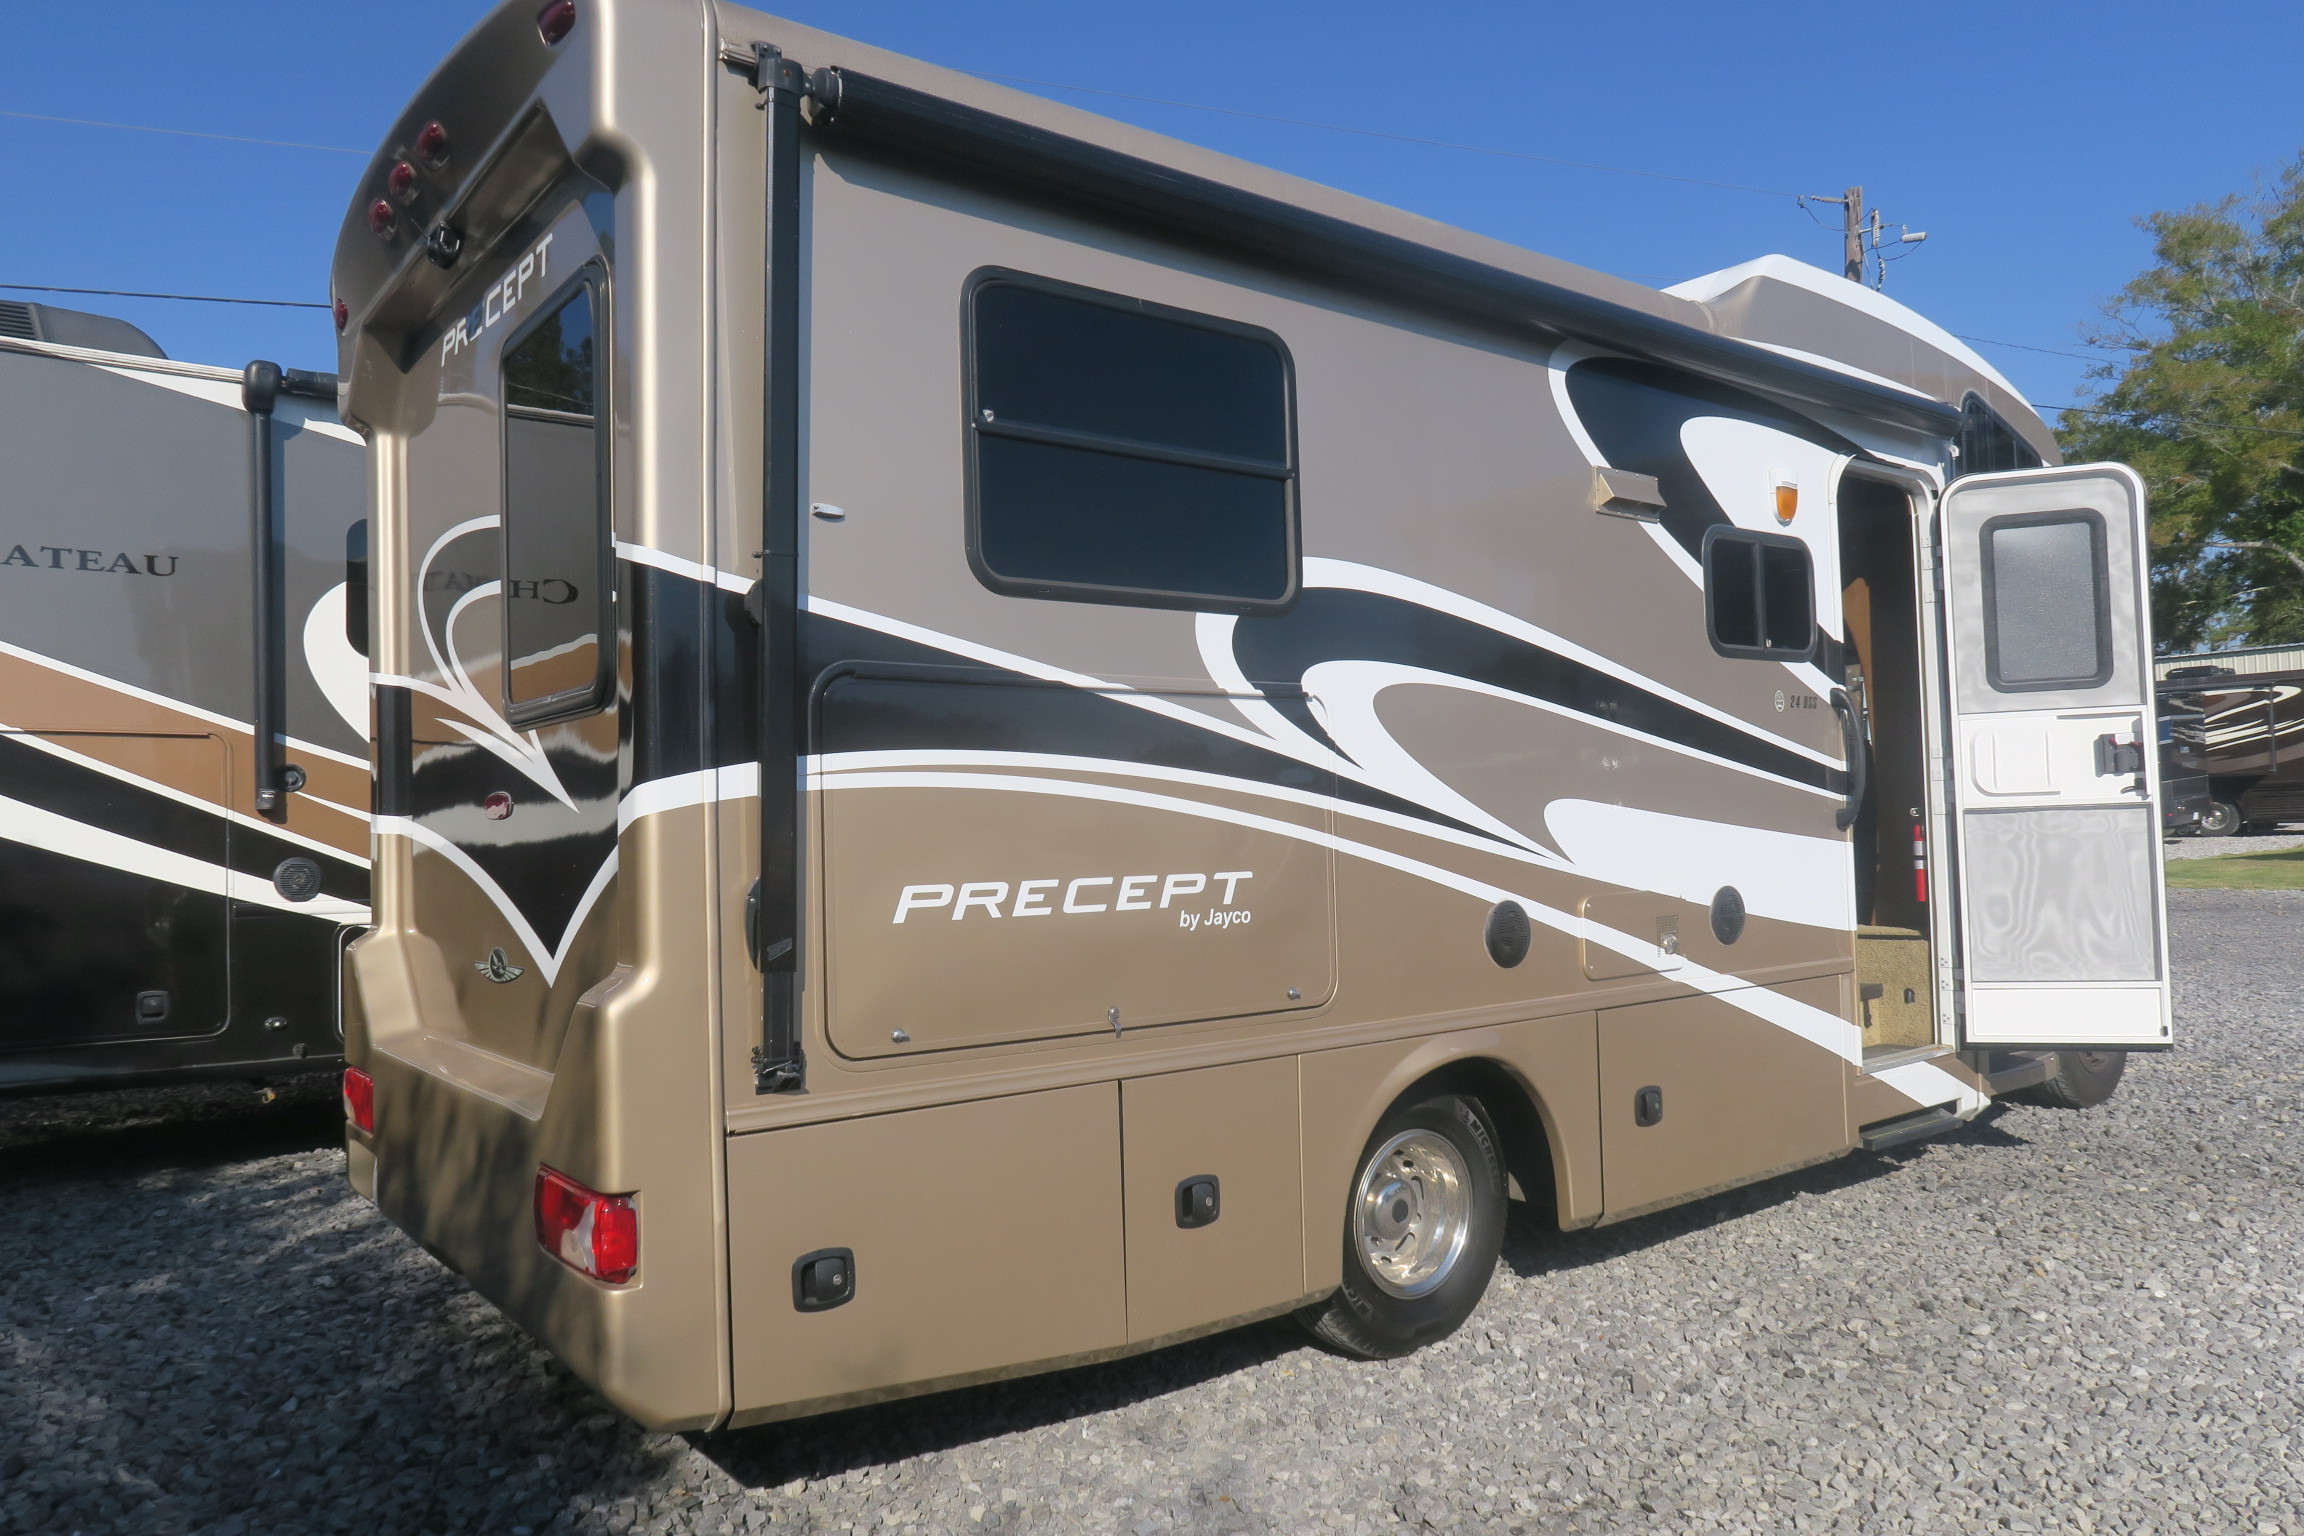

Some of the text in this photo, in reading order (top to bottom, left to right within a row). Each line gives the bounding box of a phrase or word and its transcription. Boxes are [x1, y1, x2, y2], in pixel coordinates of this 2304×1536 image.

[0, 544, 179, 577] ATEAU
[1790, 695, 1800, 708] 24
[892, 871, 1253, 924] PRECEPT
[1179, 908, 1252, 931] by Jayco
